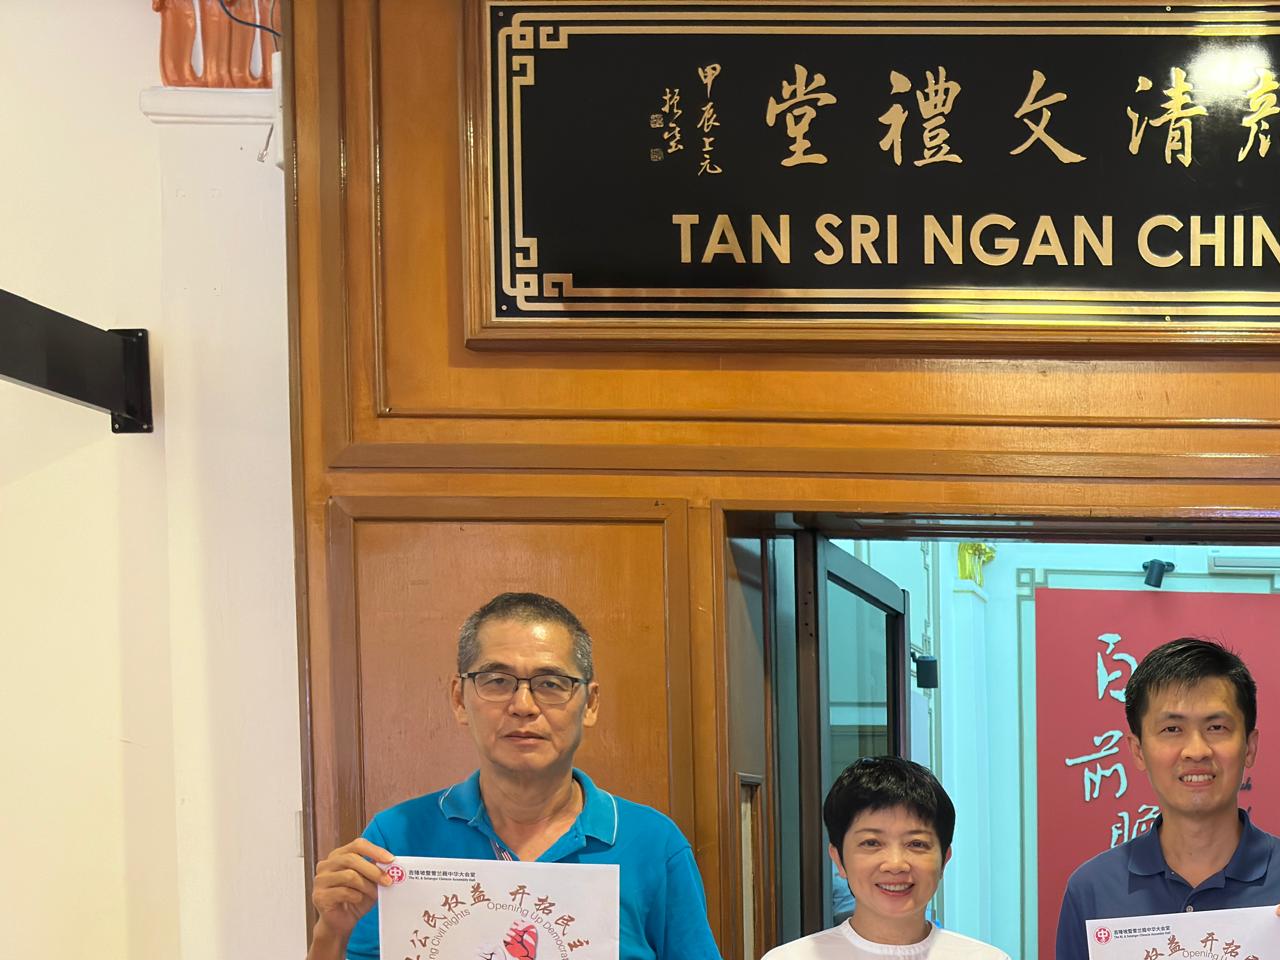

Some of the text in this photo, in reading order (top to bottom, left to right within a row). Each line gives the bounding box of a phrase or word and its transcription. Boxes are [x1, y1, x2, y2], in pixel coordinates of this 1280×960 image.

[671, 213, 792, 266] TAN
[813, 213, 898, 266] SRI
[924, 213, 1114, 268] NGAN
[432, 928, 445, 946] Civil
[443, 908, 470, 930] Rights
[487, 901, 528, 917] Opening
[530, 912, 543, 924] Up
